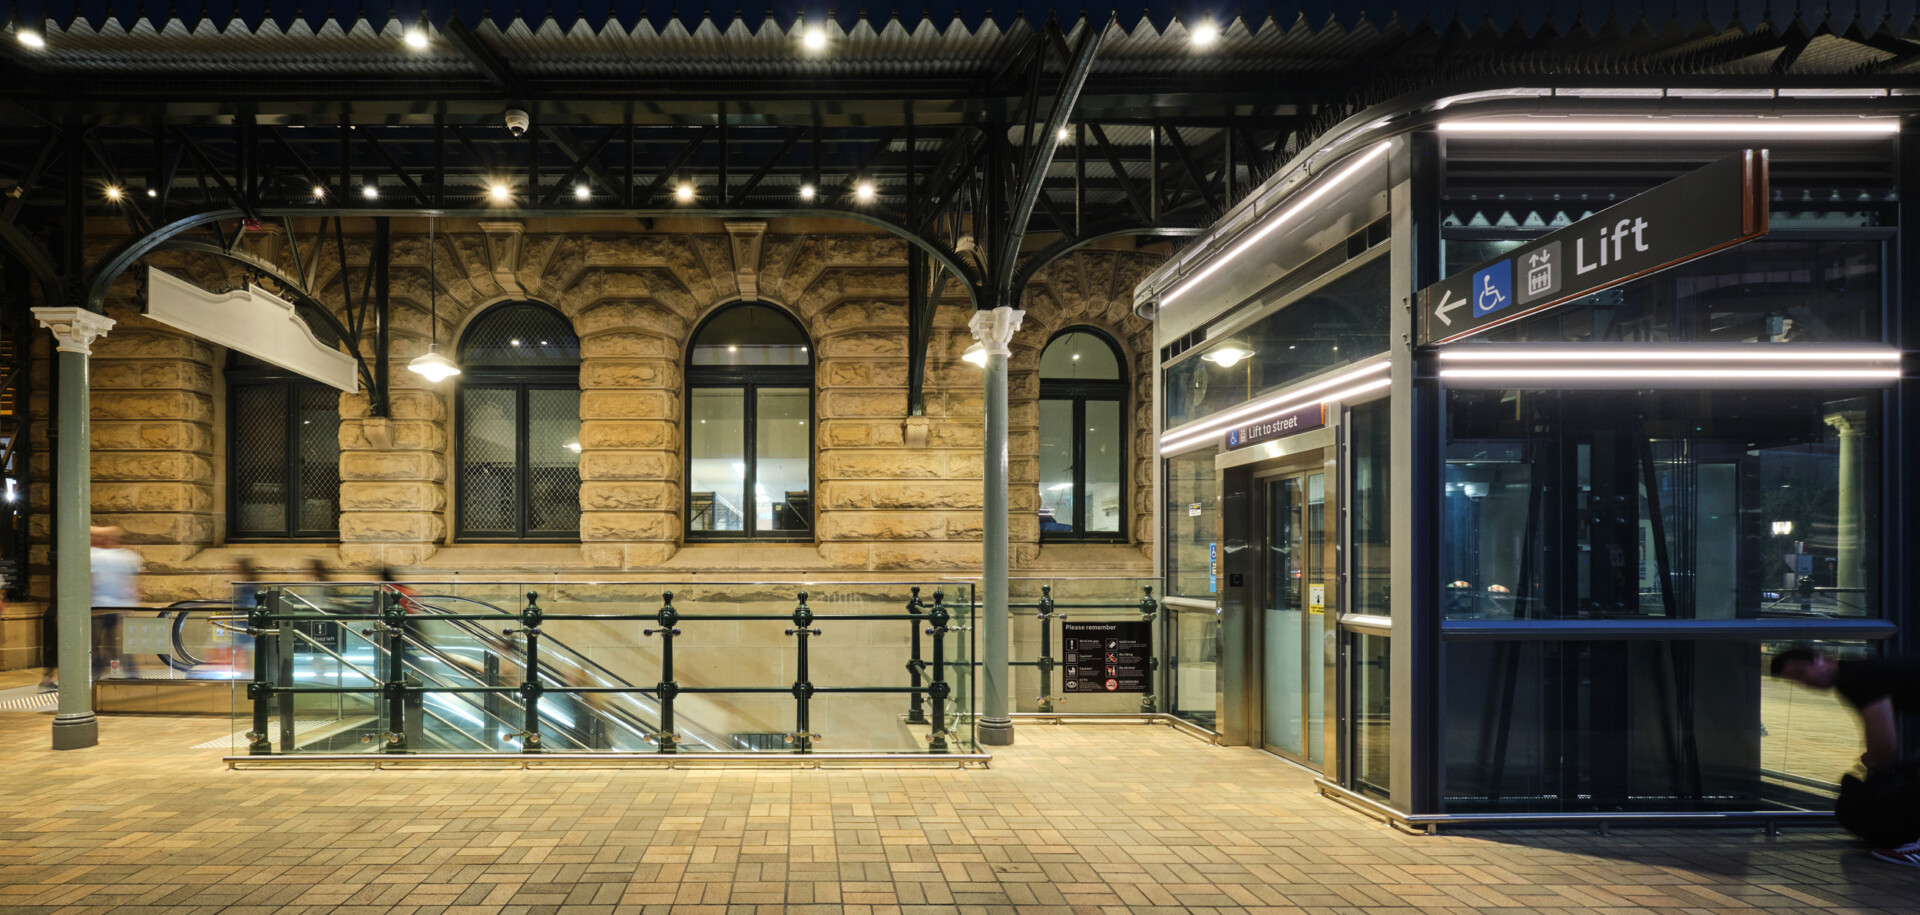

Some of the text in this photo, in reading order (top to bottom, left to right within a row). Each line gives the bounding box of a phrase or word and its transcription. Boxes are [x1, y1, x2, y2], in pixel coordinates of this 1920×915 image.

[1576, 216, 1649, 275] Lift
[1248, 415, 1298, 439] Lift to street
